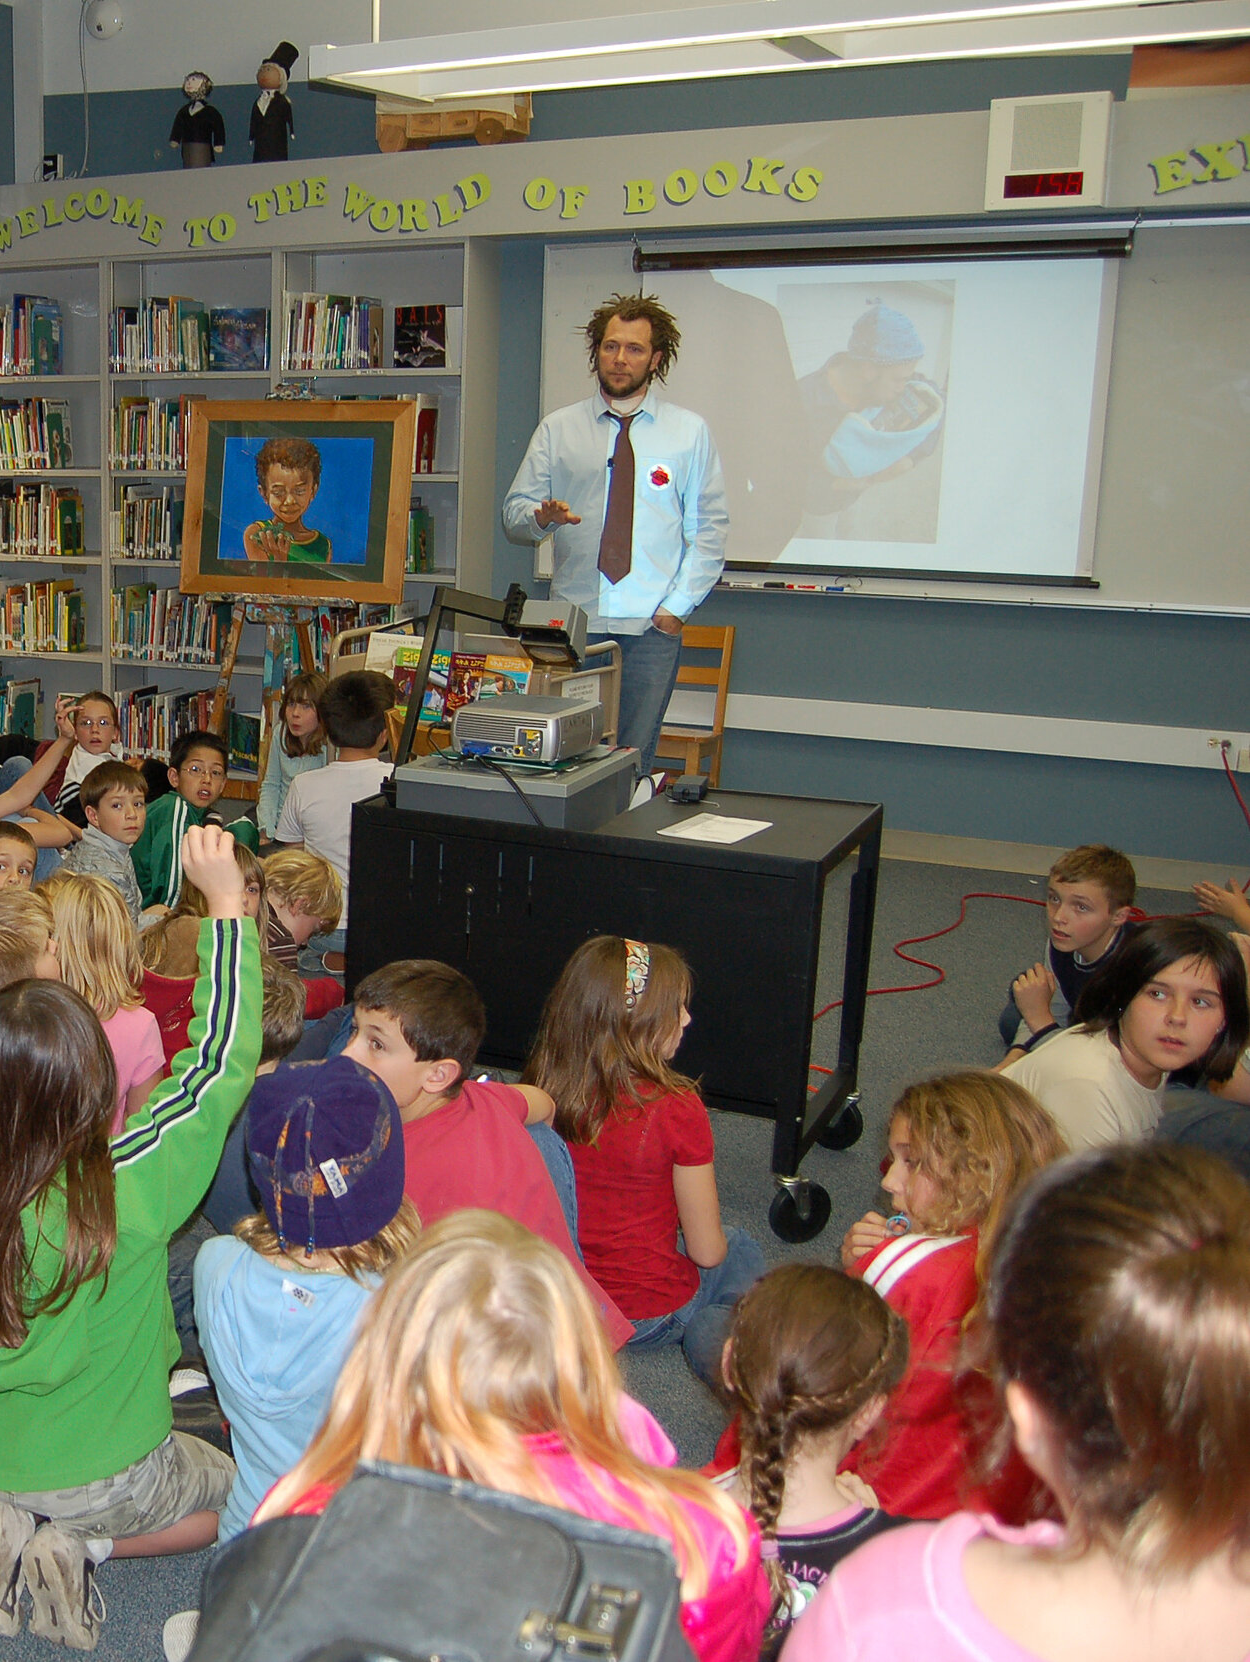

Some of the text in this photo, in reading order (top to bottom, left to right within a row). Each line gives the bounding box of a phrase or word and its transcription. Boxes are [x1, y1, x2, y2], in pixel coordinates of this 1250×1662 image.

[183, 212, 237, 248] TO
[248, 175, 329, 224] THE
[344, 172, 492, 233] WORLD
[523, 177, 589, 220] OF
[623, 156, 824, 215] BOOKS
[548, 619, 565, 627] 3M
[431, 654, 451, 665] Zig
